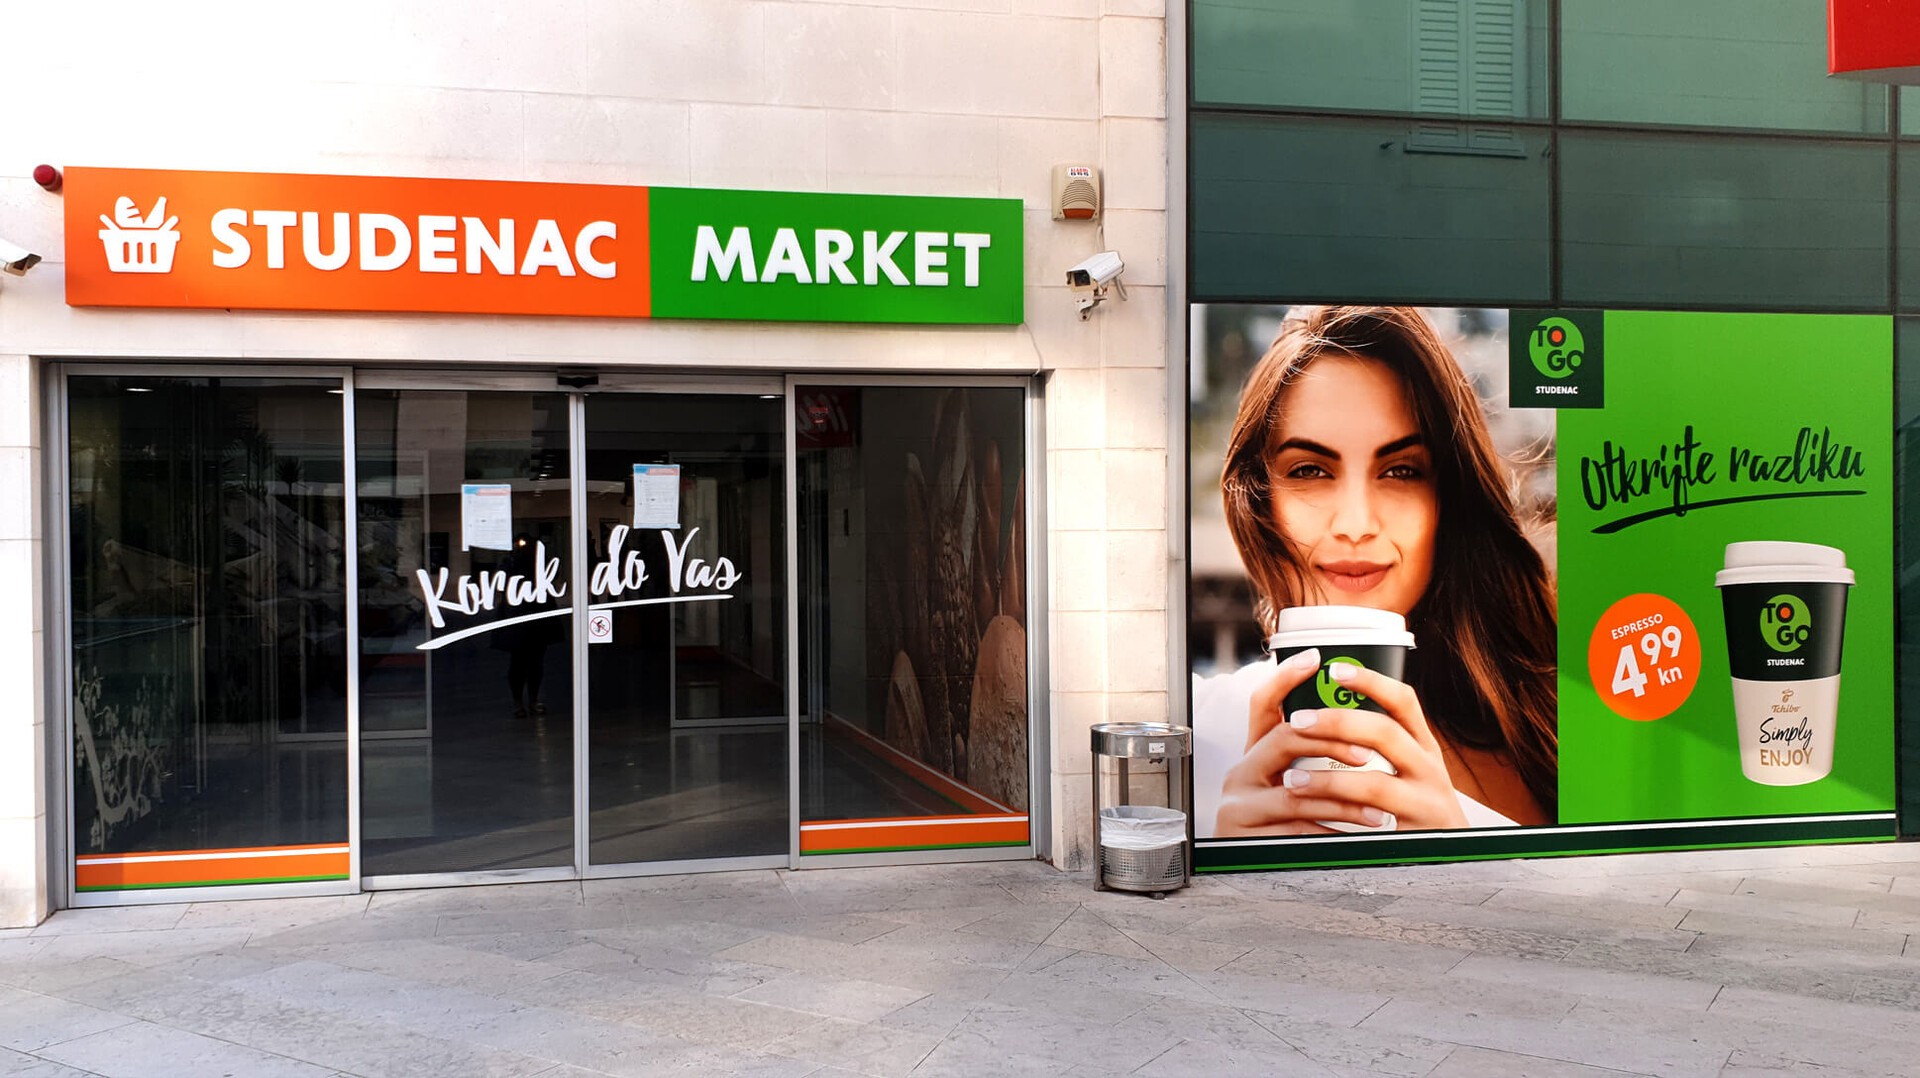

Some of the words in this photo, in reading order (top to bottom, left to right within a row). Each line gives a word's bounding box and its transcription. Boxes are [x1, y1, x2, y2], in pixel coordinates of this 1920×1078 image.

[211, 208, 617, 279] STUDENAC
[690, 225, 991, 288] MARKET
[1532, 325, 1566, 347] TO
[1547, 350, 1584, 371] GO
[1535, 385, 1578, 395] STUDENAC
[1580, 425, 1716, 516] Otkrijte
[1729, 426, 1865, 484] razliku
[416, 540, 566, 628] Korak
[591, 524, 648, 596] do
[662, 526, 742, 593] Vas
[1763, 603, 1794, 624] TO
[1611, 613, 1663, 640] ESPRESSO
[1777, 625, 1811, 645] GO
[1767, 658, 1804, 666] STUDENAC
[1658, 665, 1683, 686] kn
[1759, 717, 1813, 750] Simply
[1760, 748, 1813, 767] ENJOY
